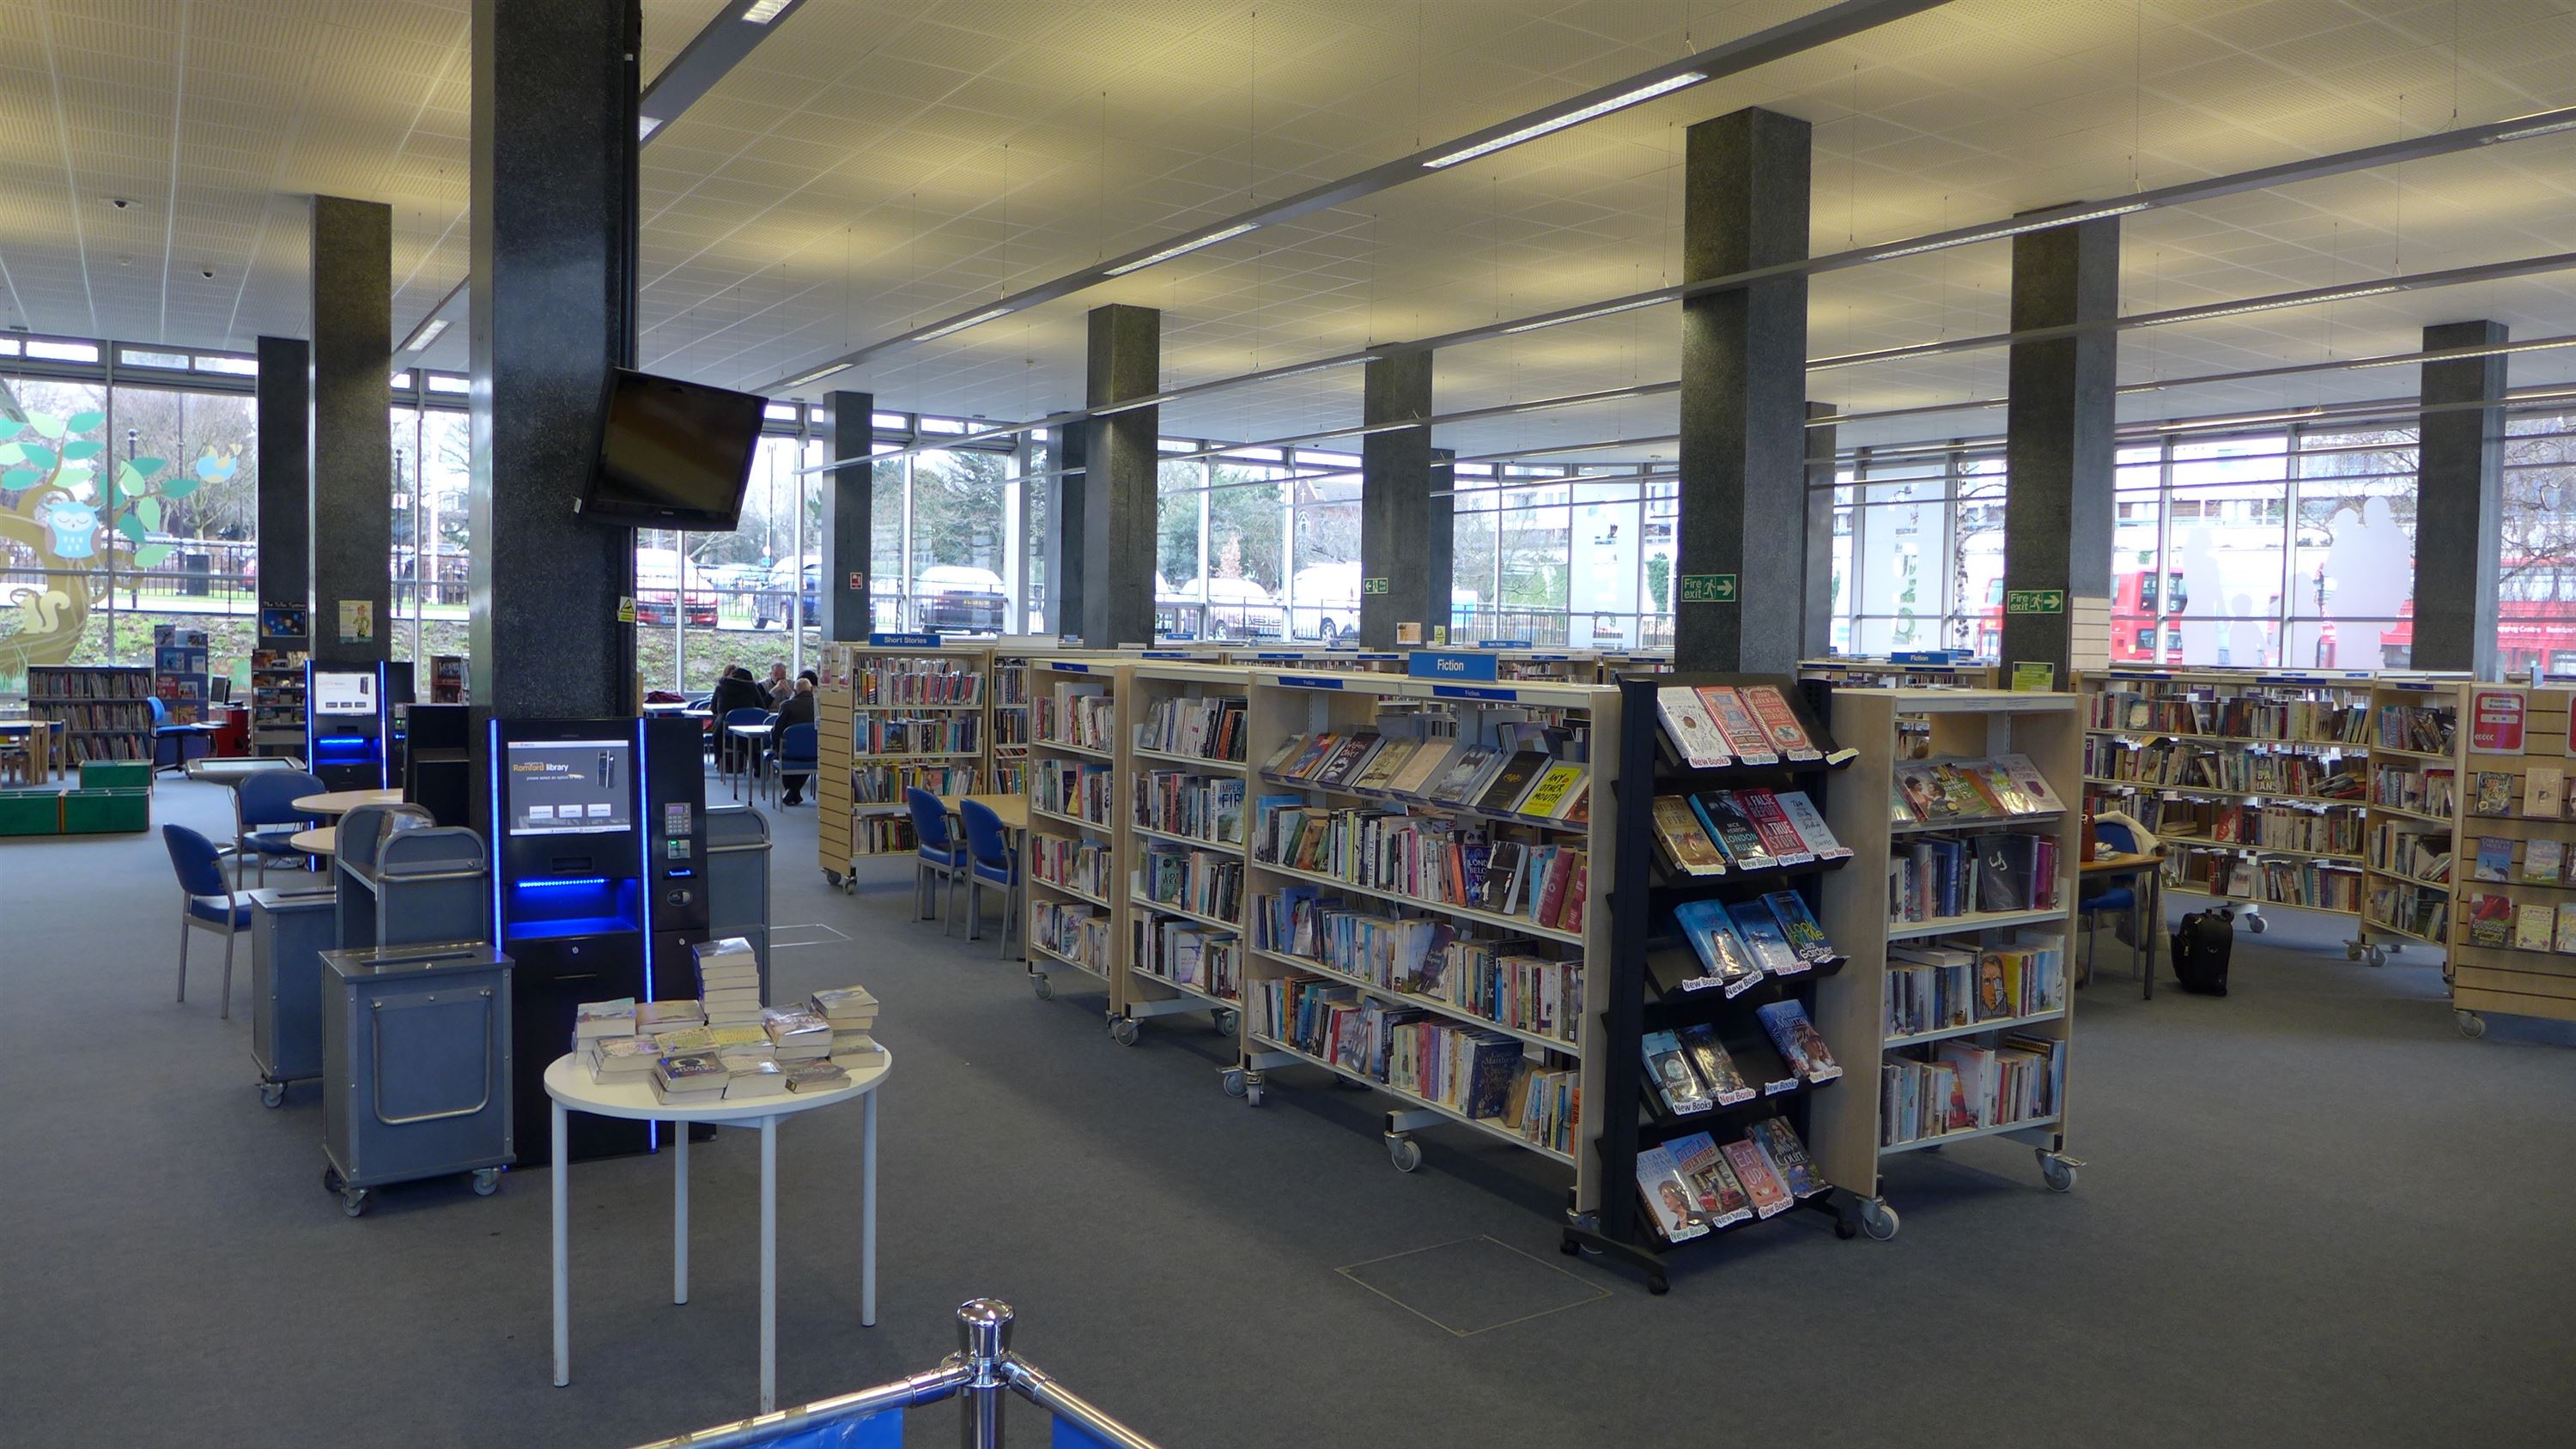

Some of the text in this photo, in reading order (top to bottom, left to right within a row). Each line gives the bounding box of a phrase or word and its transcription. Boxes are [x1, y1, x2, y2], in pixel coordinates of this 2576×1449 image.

[1684, 579, 1702, 589] Fire
[1684, 589, 1702, 599] exit
[2010, 593, 2028, 602] Fire
[2010, 603, 2028, 611] exit
[1437, 658, 1464, 671] Fiction
[1708, 756, 1728, 765] Books
[546, 763, 568, 772] library
[1547, 773, 1567, 784] ANY
[1540, 784, 1565, 792] OTHER
[1745, 794, 1775, 807] A FALSE
[1750, 805, 1781, 818] REPORT
[1768, 822, 1794, 835] TRUE
[1724, 833, 1758, 844] LONDON
[1769, 833, 1801, 849] STORY
[1735, 842, 1756, 852] RULES
[1787, 919, 1817, 933] Look
[1799, 945, 1833, 959] Gardner
[1792, 961, 1810, 971] Books
[1684, 978, 1720, 989] New Books
[1726, 972, 1762, 996] New Books
[1765, 1080, 1797, 1092] New Books
[1720, 1090, 1754, 1103] New Books
[1674, 1101, 1711, 1113] New Books
[1681, 1146, 1716, 1173] ADVENTURE
[1733, 1149, 1759, 1167] EAT
[1776, 1151, 1806, 1167] Court
[1745, 1167, 1767, 1184] UP!
[1760, 1198, 1793, 1216] New Books
[1715, 1215, 1731, 1225] New
[1670, 1226, 1708, 1240] New Books
